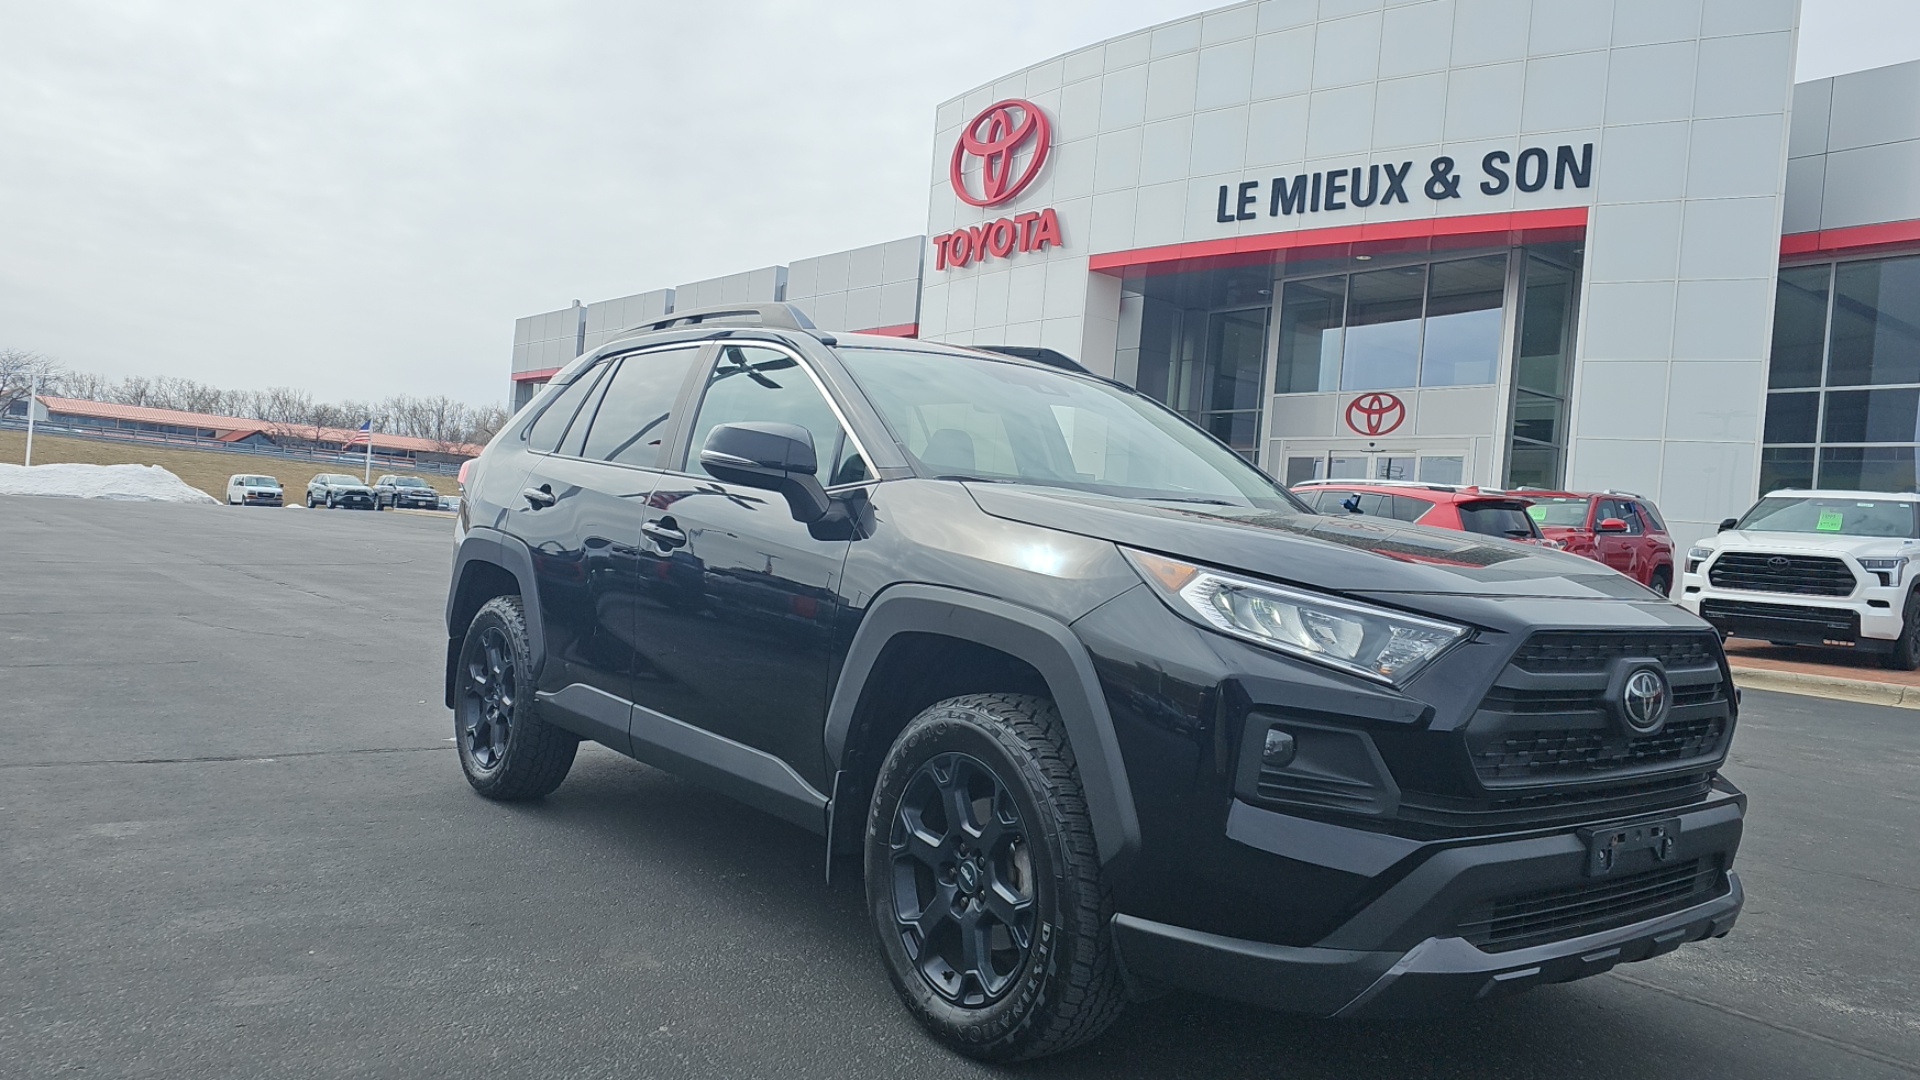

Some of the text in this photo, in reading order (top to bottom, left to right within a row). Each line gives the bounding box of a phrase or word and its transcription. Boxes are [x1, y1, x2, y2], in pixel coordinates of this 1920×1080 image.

[1217, 143, 1593, 223] LE MIEUX & SON
[933, 208, 1063, 271] TOYOTA
